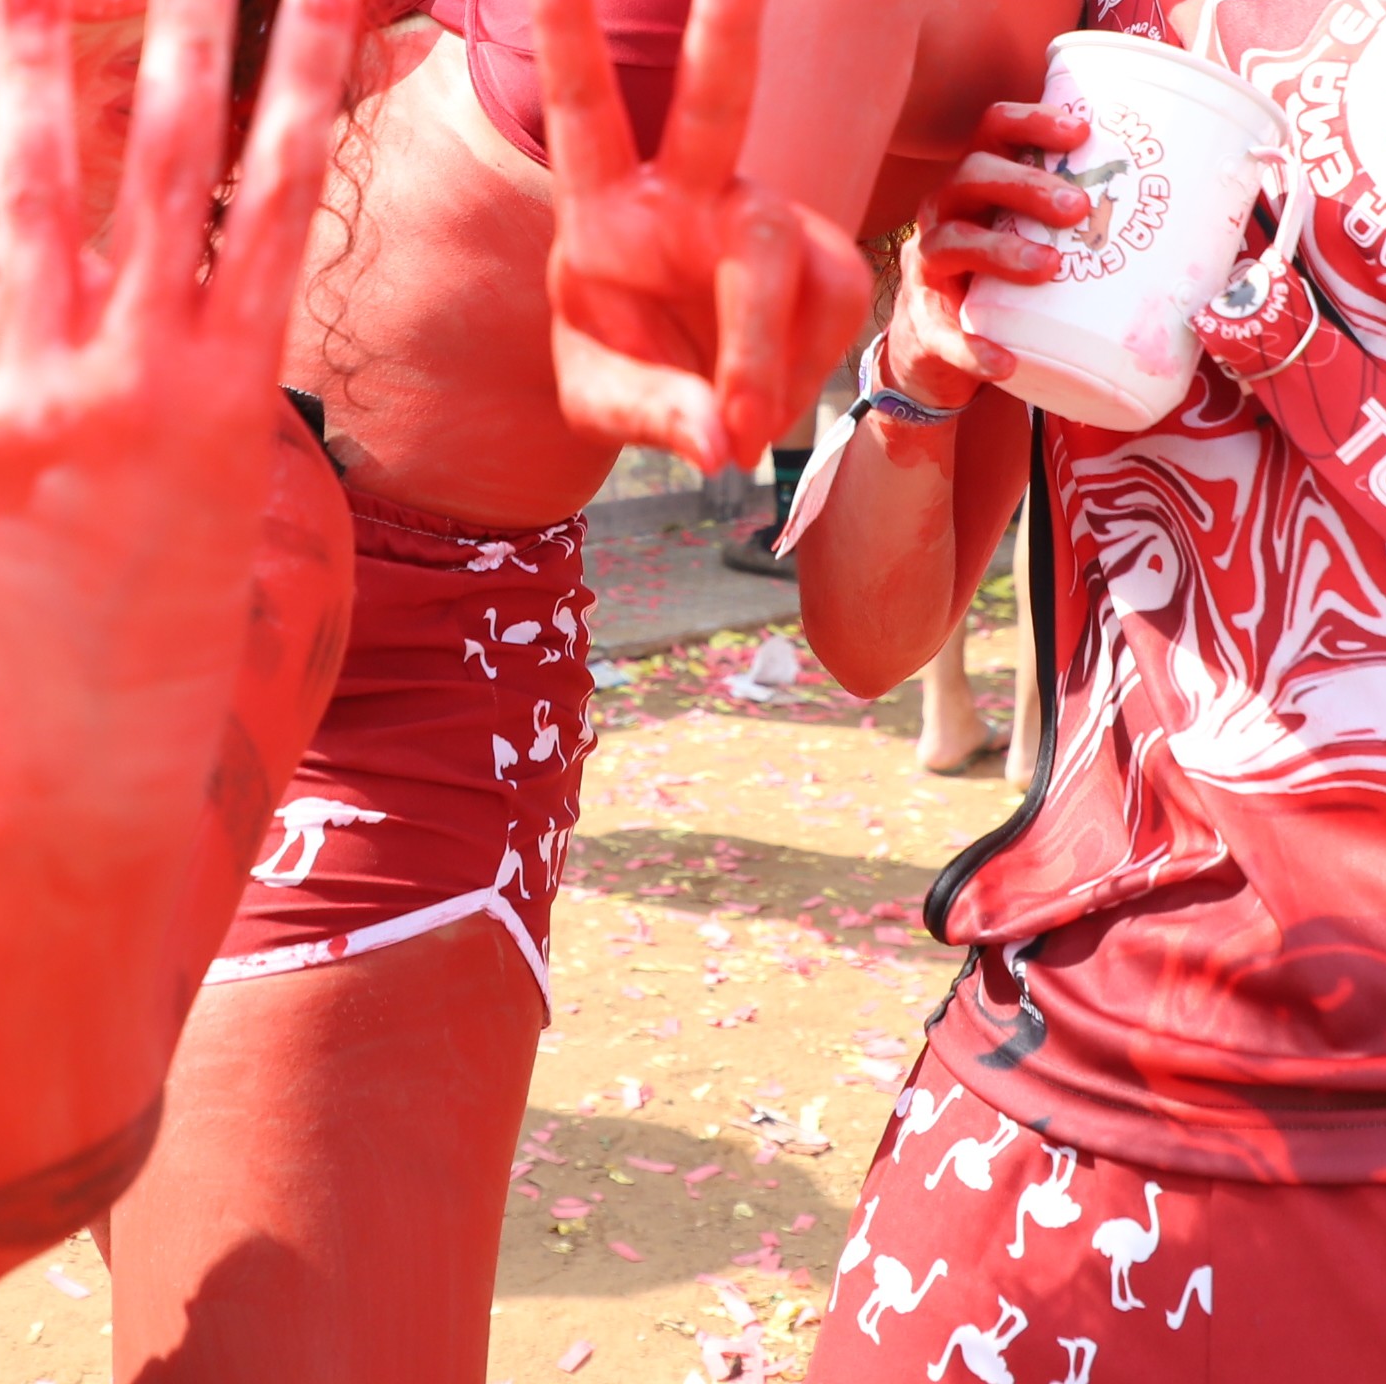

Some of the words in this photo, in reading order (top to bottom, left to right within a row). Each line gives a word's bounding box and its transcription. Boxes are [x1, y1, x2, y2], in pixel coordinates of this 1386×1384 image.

[1099, 103, 1164, 170] EMA
[1293, 59, 1351, 199] EMA
[1117, 174, 1171, 251] EMA
